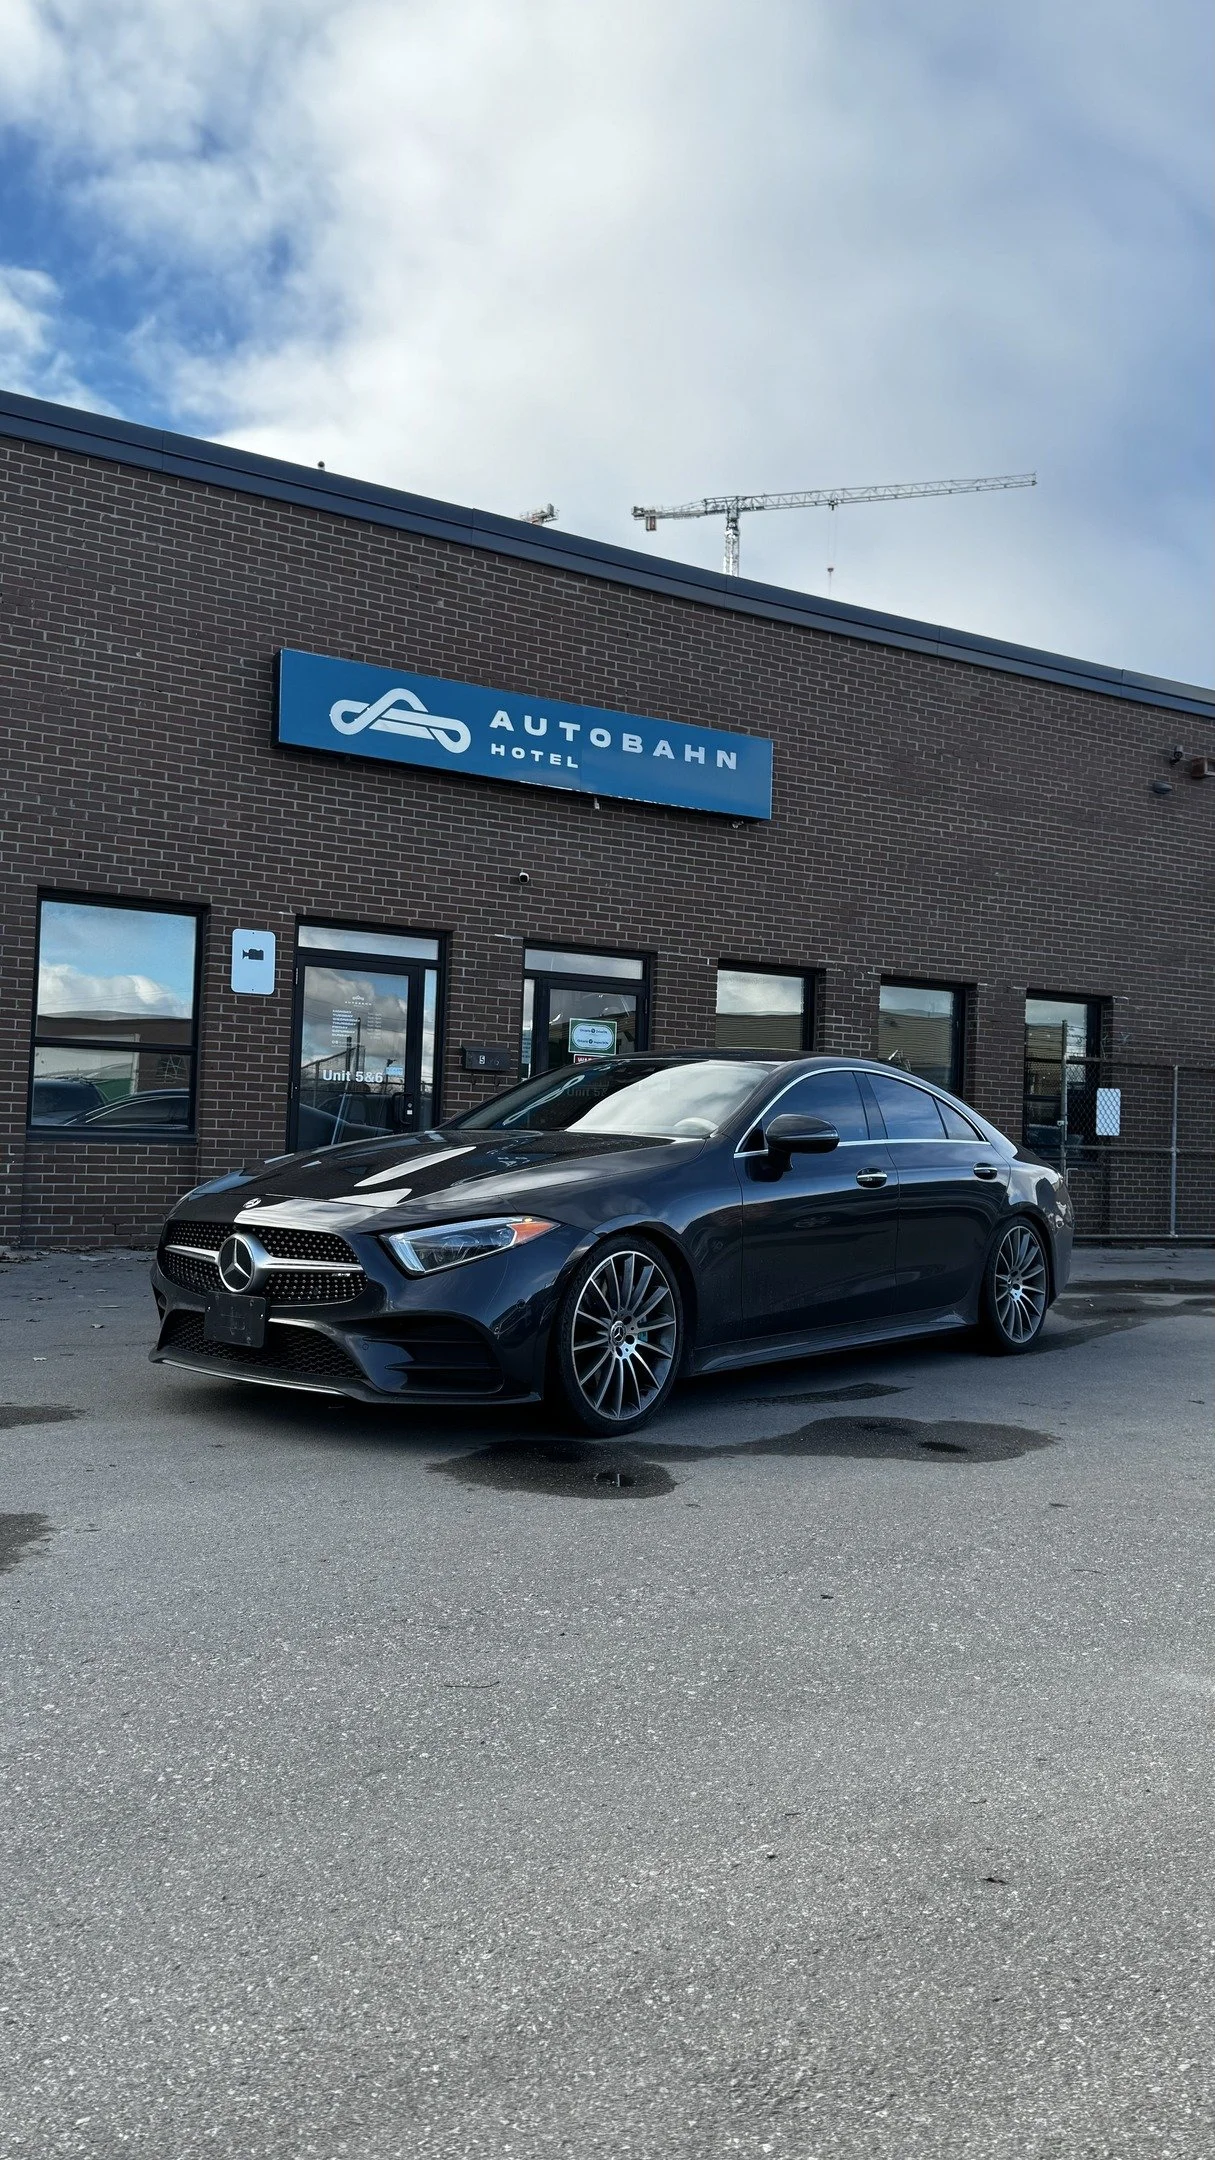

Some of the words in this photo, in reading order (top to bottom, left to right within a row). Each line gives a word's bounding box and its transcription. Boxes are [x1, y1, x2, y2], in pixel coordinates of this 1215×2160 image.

[489, 710, 738, 770] AUTOBAHN
[491, 743, 579, 769] HOTEL
[322, 1069, 351, 1082] Unit
[355, 1071, 384, 1083] 5&6
